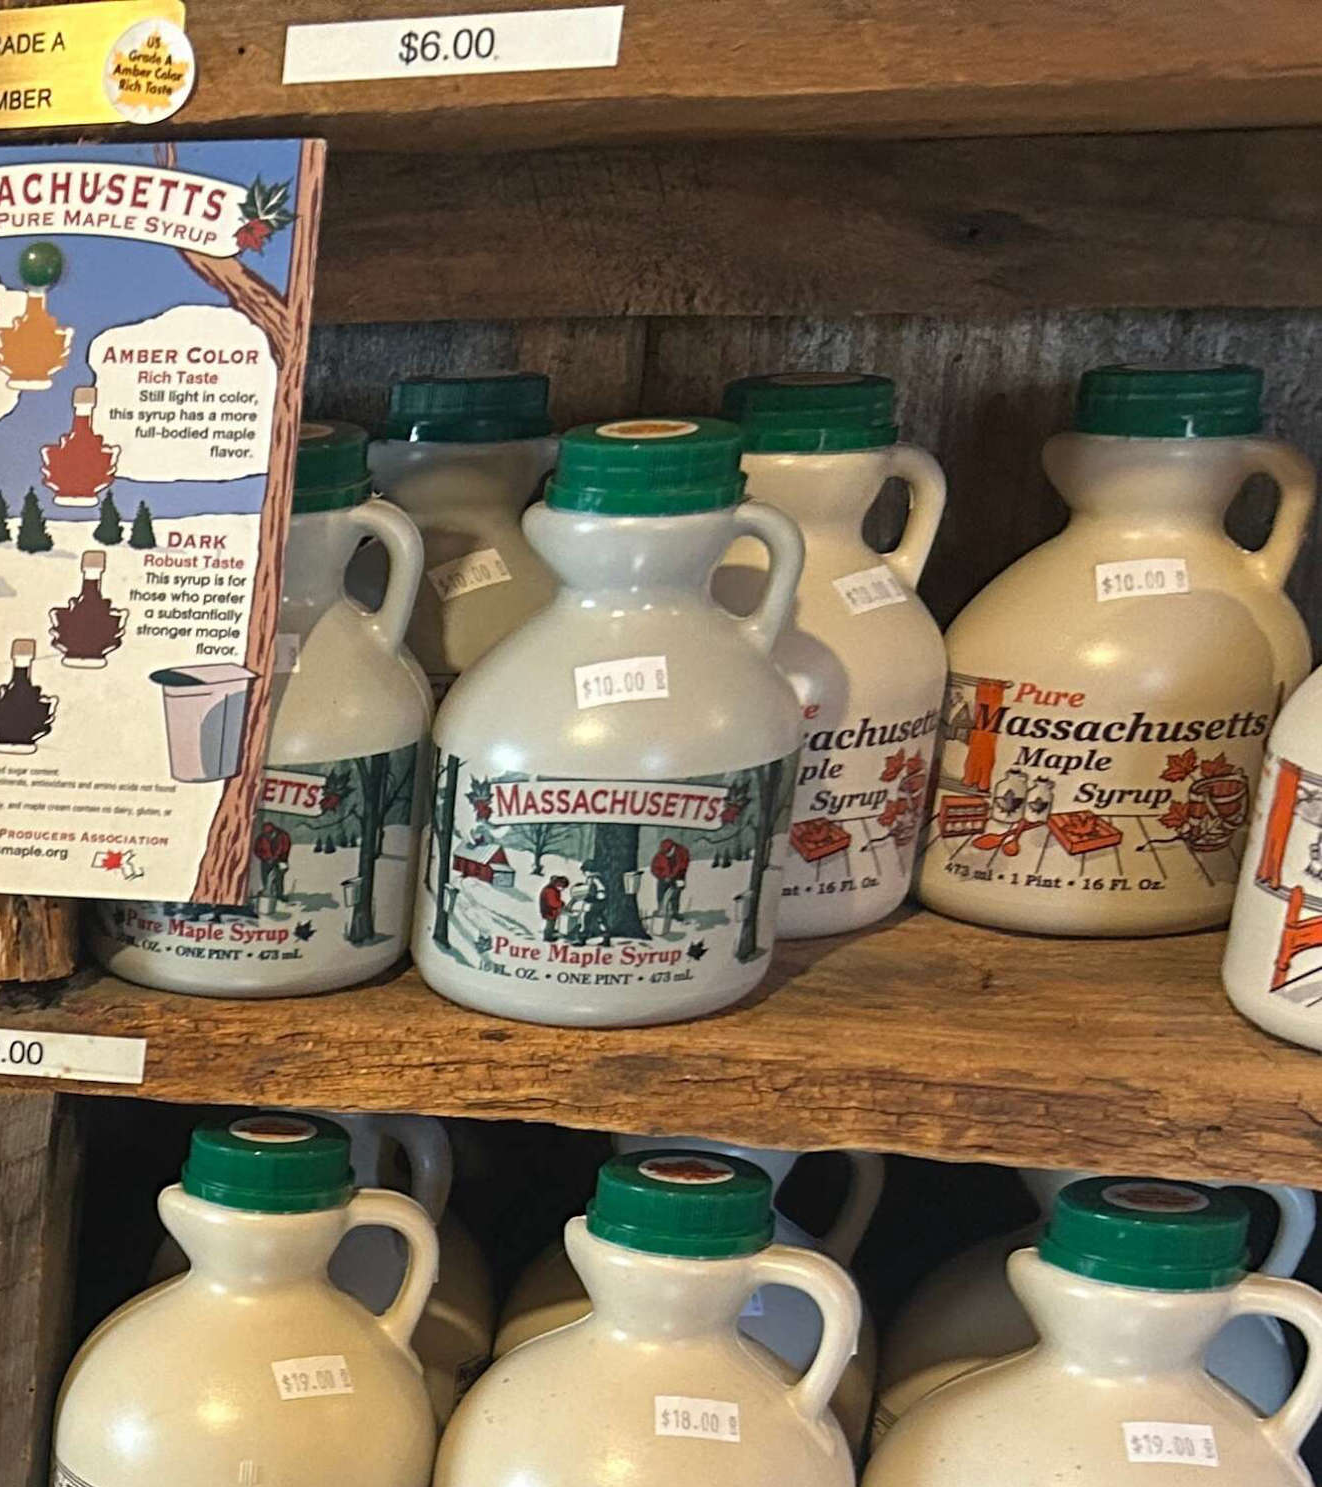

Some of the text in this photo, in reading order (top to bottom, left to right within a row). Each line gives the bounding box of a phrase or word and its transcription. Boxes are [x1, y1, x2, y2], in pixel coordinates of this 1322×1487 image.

[51, 32, 65, 51] A
[399, 28, 496, 64] $6.00
[128, 51, 173, 65] Grade A
[113, 65, 184, 81] Amber Color
[118, 79, 173, 95] Rich Taste
[64, 211, 135, 229] MAPLE
[145, 218, 218, 246] SYRUP
[103, 347, 258, 364] AMBER COLOR
[138, 371, 218, 384] Rich Taste
[169, 531, 227, 548] DARK
[144, 554, 244, 569] Robust Taste
[583, 671, 644, 699] $10.00
[1014, 683, 1085, 707] Pure
[973, 704, 1269, 743] Massachusetts
[1014, 747, 1112, 774] Maple
[495, 784, 721, 821] MASSACHUSETTS
[1073, 783, 1173, 808] Syrup
[0, 828, 76, 842] PRODUCERS
[81, 832, 169, 846] ASSOCIATION
[495, 936, 681, 967] Pure Maple Syrup
[661, 1408, 720, 1433] $18.00
